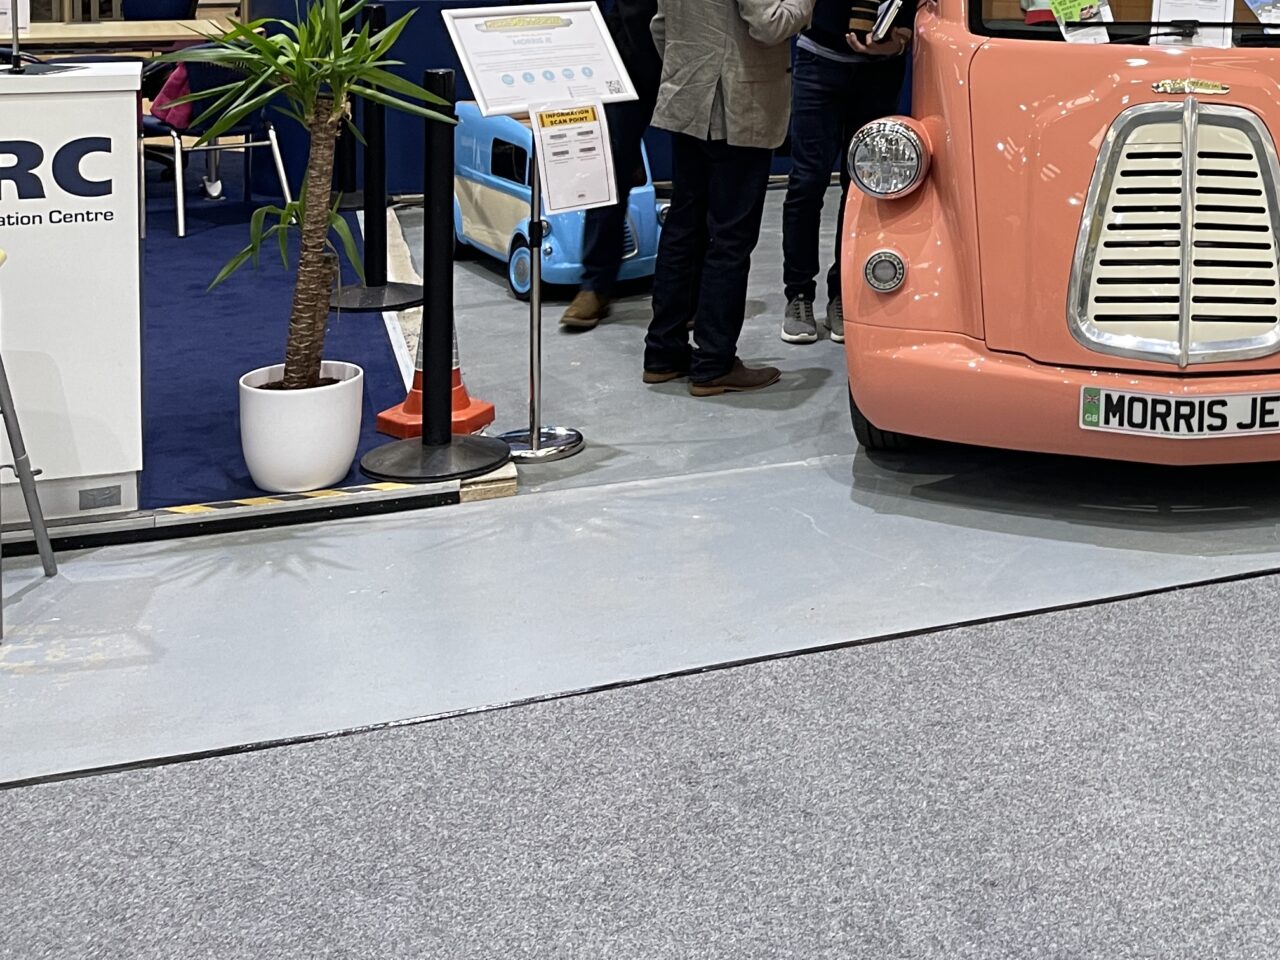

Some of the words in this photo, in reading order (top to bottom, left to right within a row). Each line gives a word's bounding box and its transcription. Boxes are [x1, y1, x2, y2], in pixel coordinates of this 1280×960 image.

[550, 118, 568, 126] SCAN
[569, 116, 588, 124] POINT
[49, 209, 114, 224] Centre
[1084, 414, 1098, 422] GB
[1104, 393, 1228, 433] MORRIS
[1236, 395, 1280, 430] JE
